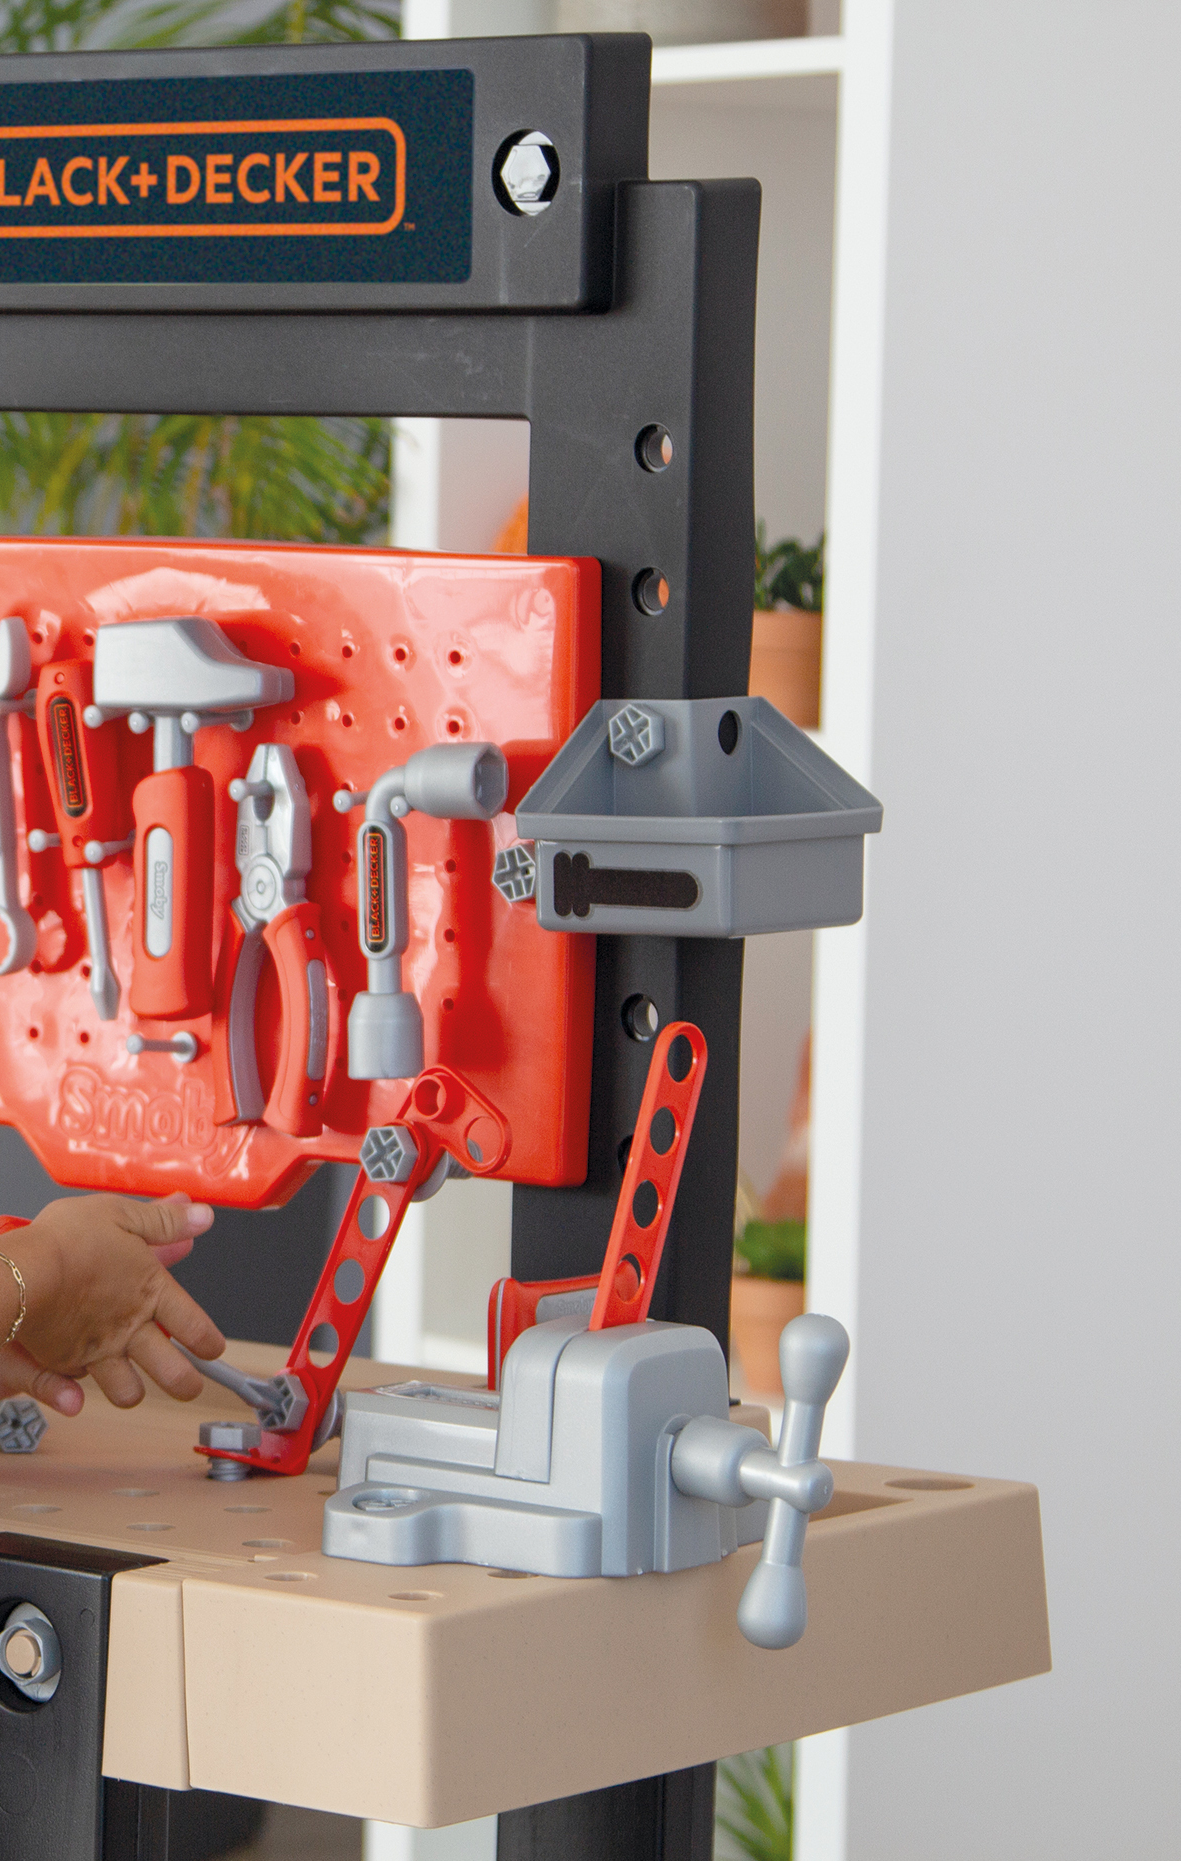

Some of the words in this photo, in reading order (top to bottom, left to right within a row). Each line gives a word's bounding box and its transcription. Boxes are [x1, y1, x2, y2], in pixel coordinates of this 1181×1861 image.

[59, 709, 80, 803] BLACK+DECKER
[150, 861, 168, 919] Smoby
[370, 838, 380, 937] BLACK+DECKER
